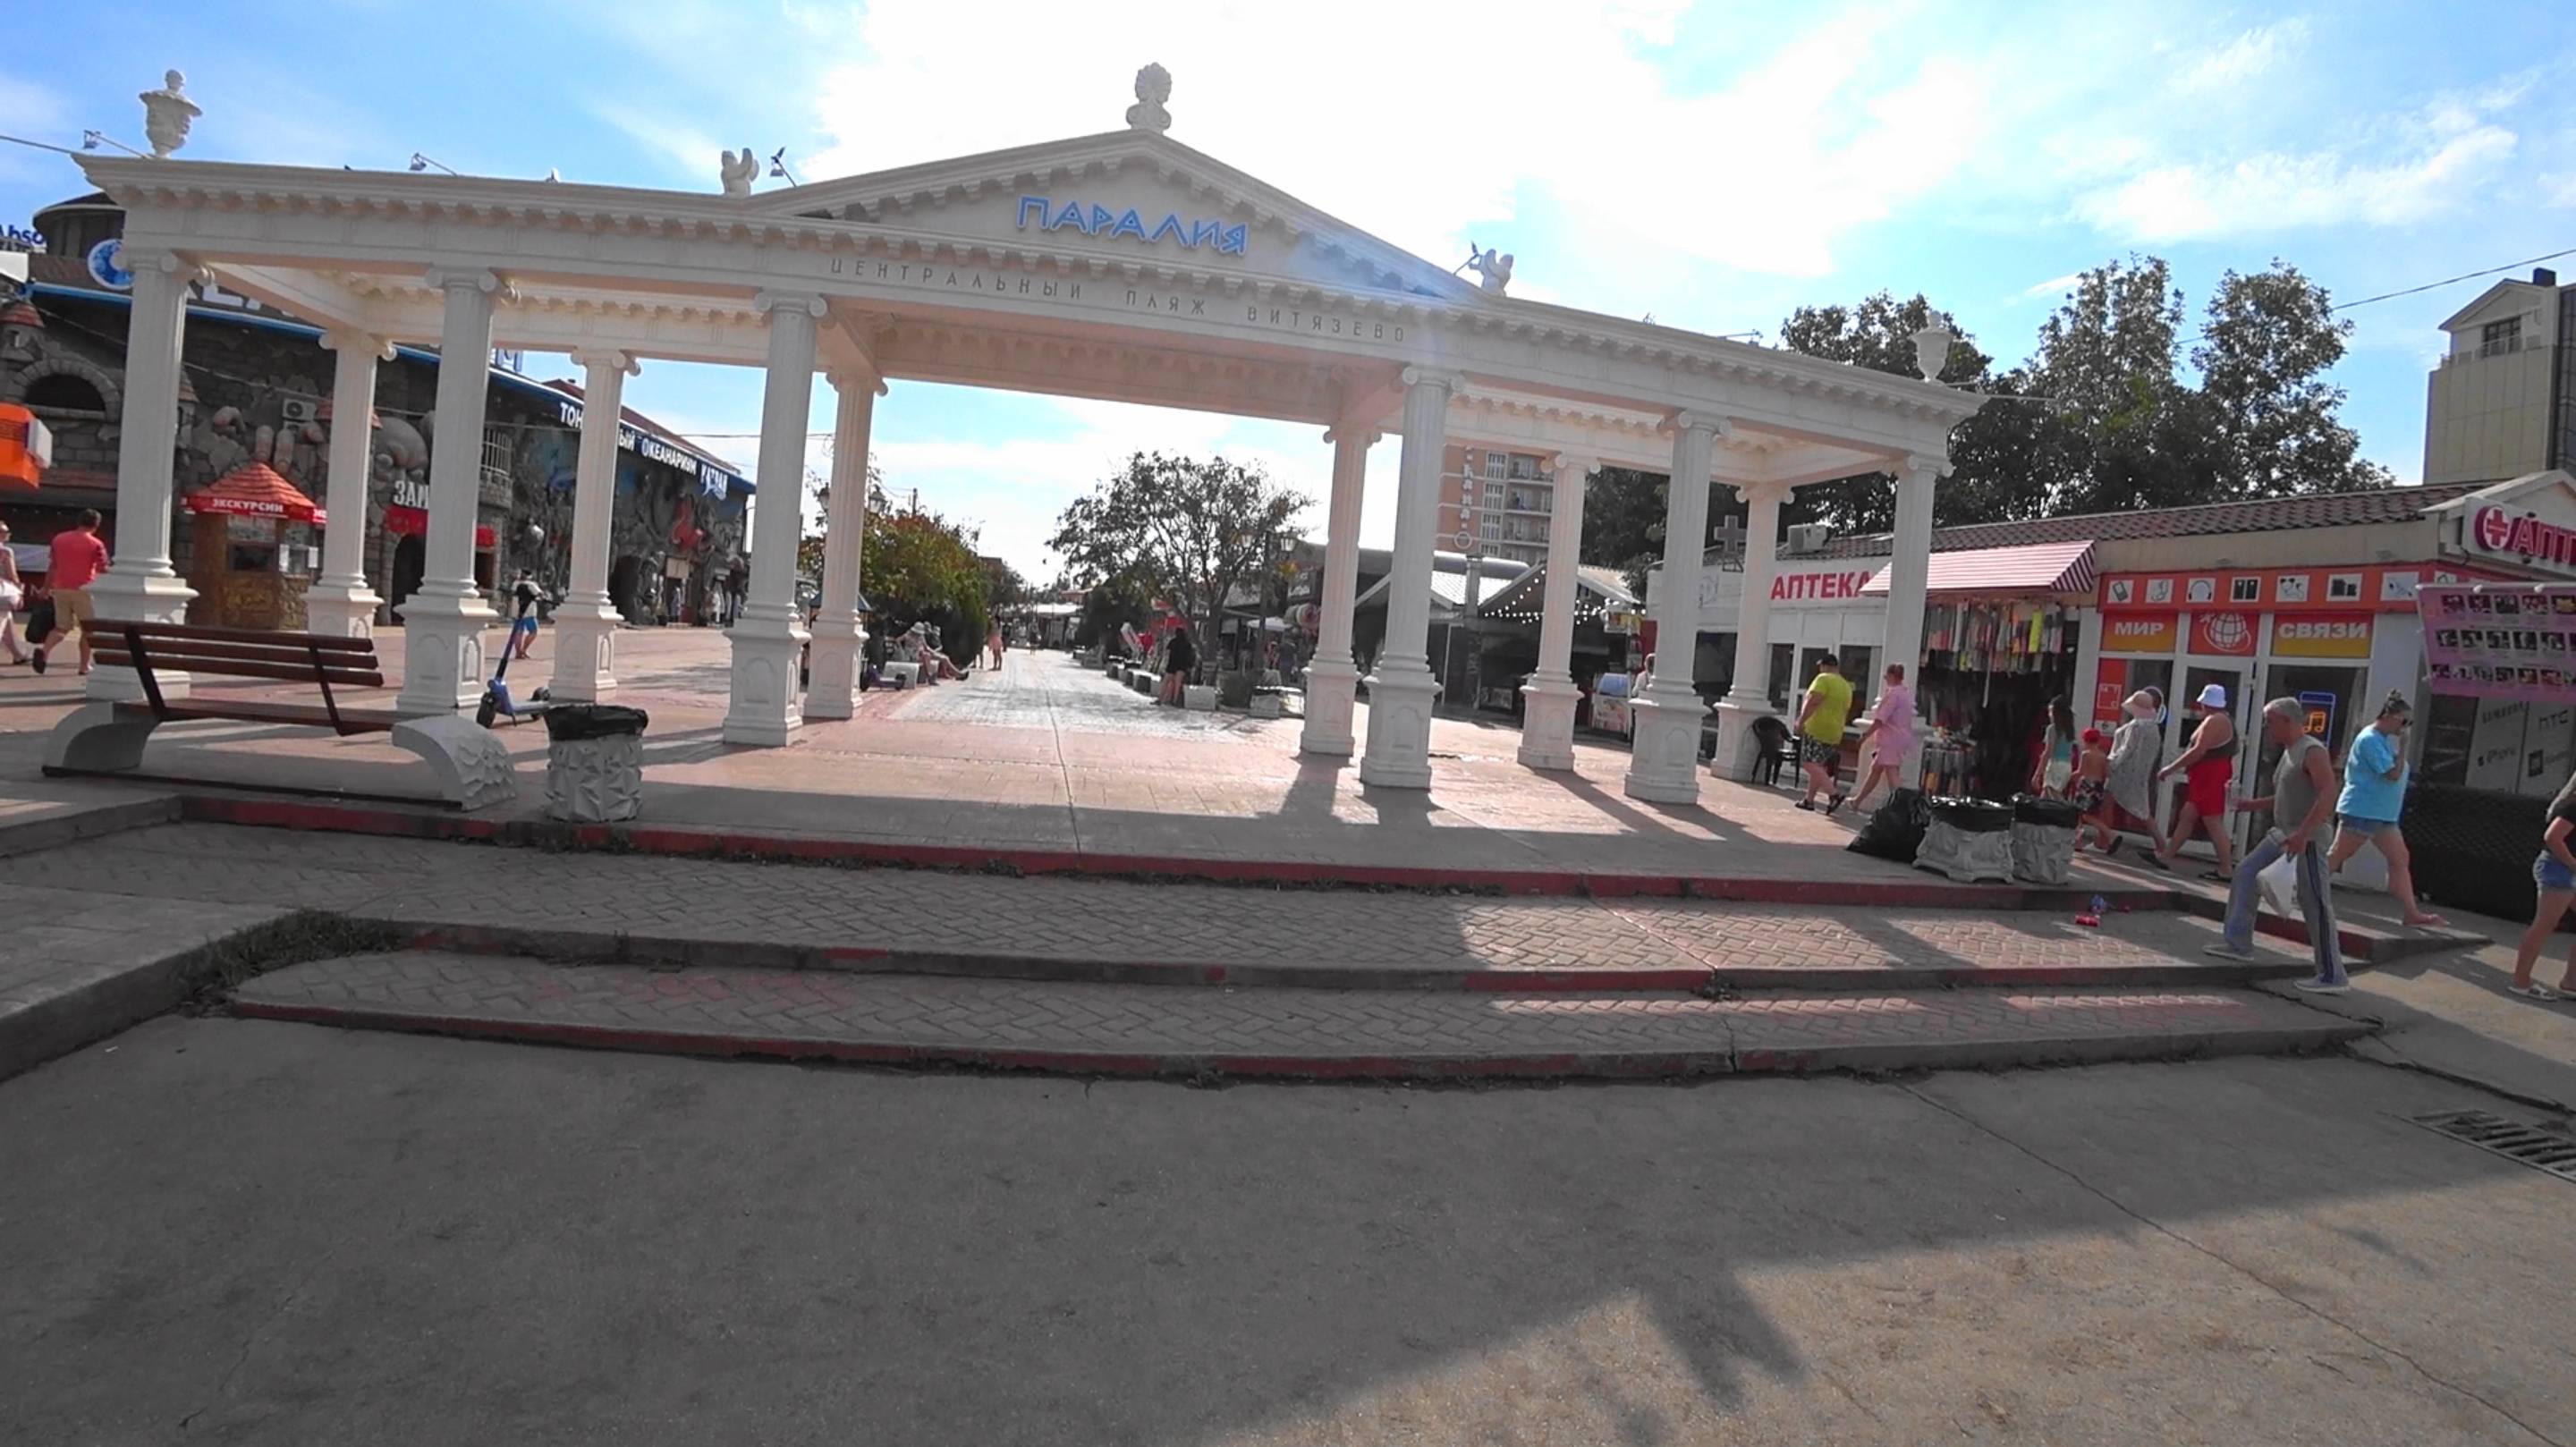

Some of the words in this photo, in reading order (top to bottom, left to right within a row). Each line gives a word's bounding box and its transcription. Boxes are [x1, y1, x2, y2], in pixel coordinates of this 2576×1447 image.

[1016, 195, 1249, 257] ПАРАЛИЯ
[1125, 289, 1205, 315] ПЛЯЖ
[1247, 306, 1404, 343] ВИТЯЗЕВО
[212, 498, 284, 513] ЭКСКУРСИИ
[2114, 622, 2165, 637] МИР
[2278, 622, 2368, 639] СВЯЗИ
